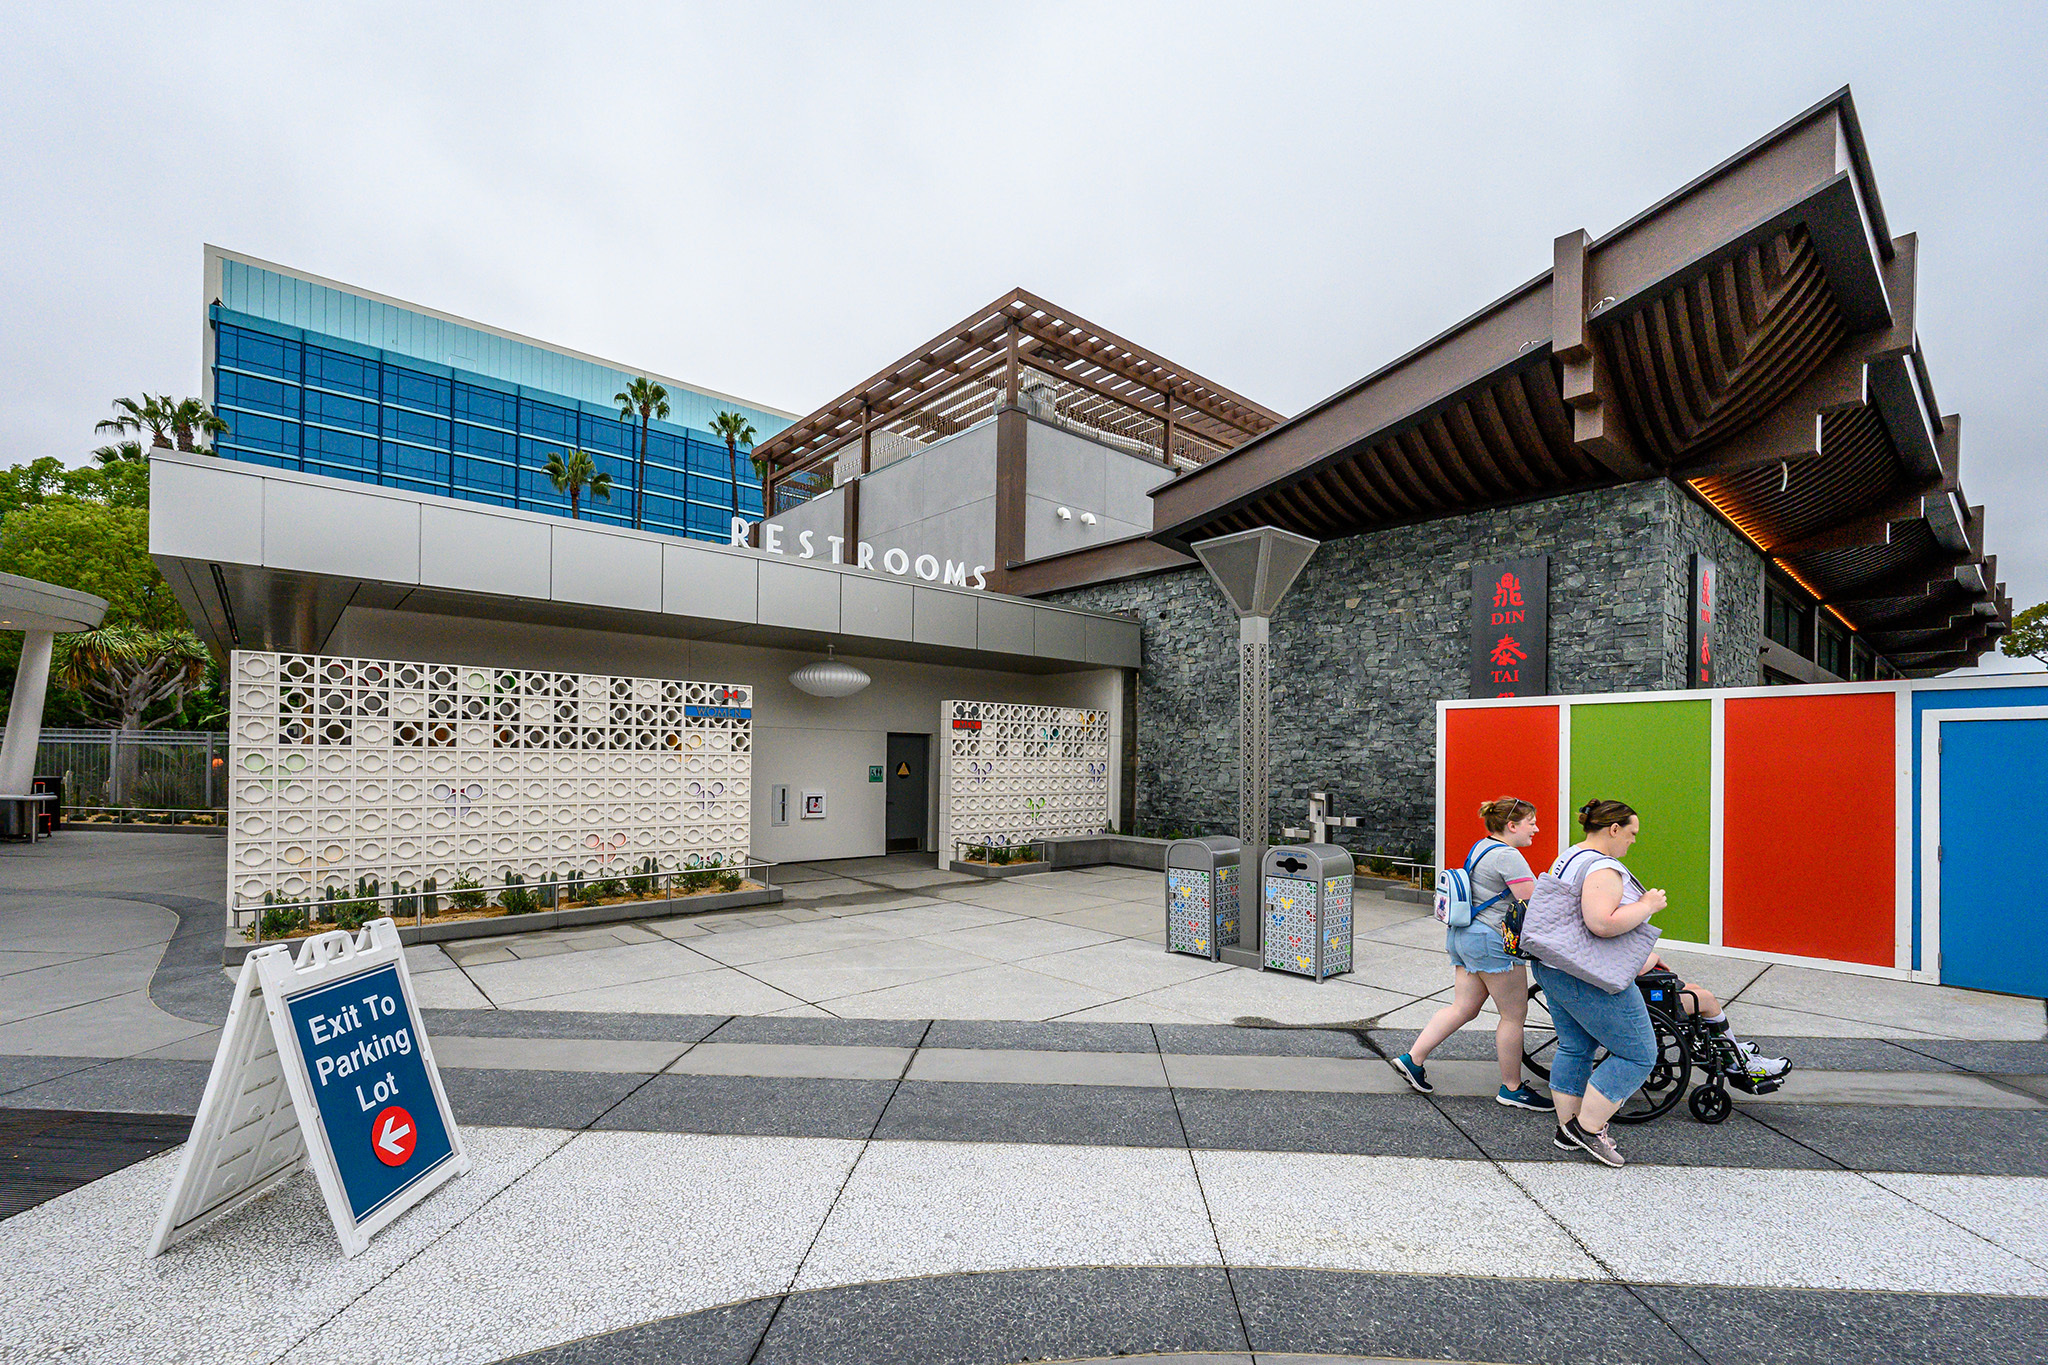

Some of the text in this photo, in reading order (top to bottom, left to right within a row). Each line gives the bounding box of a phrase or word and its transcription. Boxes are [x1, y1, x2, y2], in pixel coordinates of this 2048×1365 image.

[731, 516, 987, 590] RESTROOMS
[1492, 572, 1524, 608] 鼎
[1490, 610, 1526, 626] DIN
[1490, 633, 1528, 666] 泰
[1490, 669, 1520, 683] TAI
[696, 706, 742, 719] WOMEN
[308, 994, 396, 1046] Exit To
[315, 1027, 412, 1087] Parking
[355, 1071, 399, 1112] Lot
